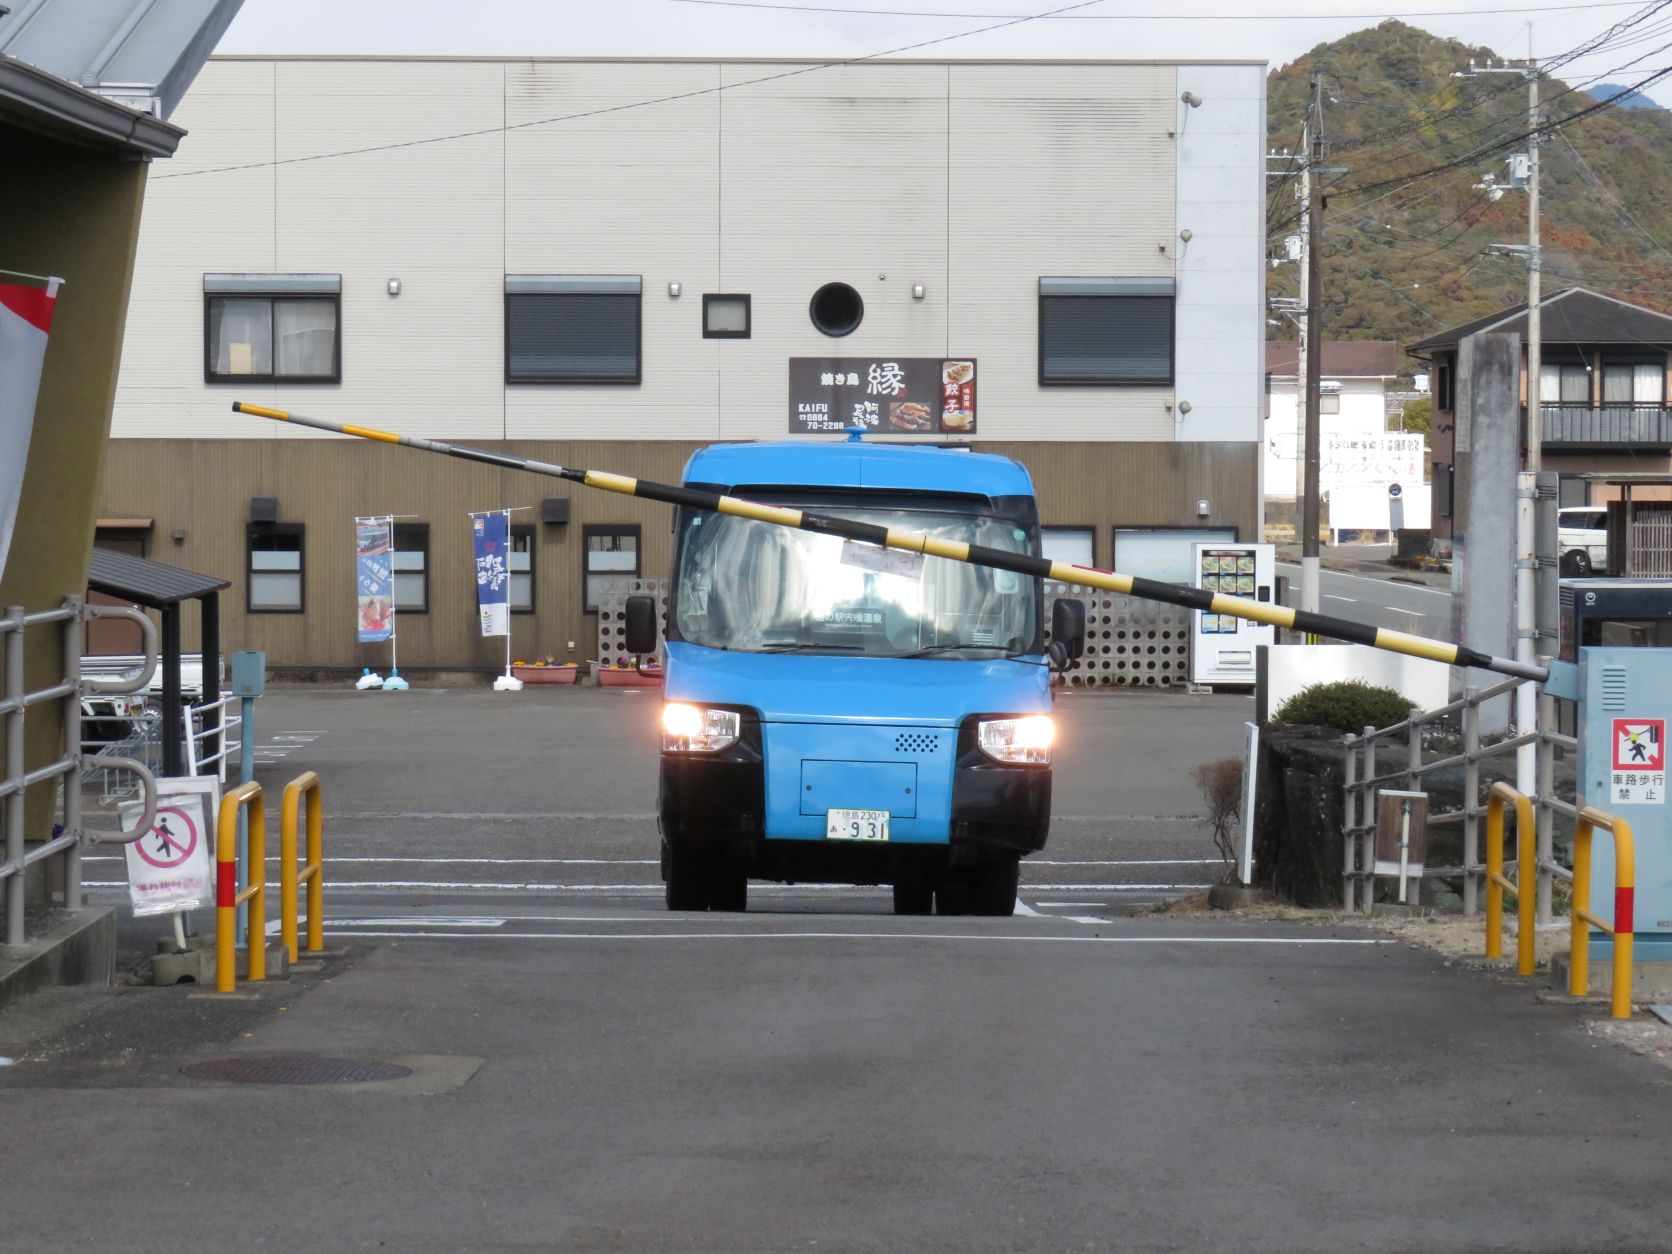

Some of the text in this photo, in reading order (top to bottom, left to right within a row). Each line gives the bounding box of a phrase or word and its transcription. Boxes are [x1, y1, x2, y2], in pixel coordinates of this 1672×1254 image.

[820, 373, 860, 386] 焼き鳥
[867, 362, 905, 395] 縁
[945, 383, 959, 412] 餃子
[798, 403, 828, 412] KAIFU
[1612, 774, 1664, 786] 車路歩行
